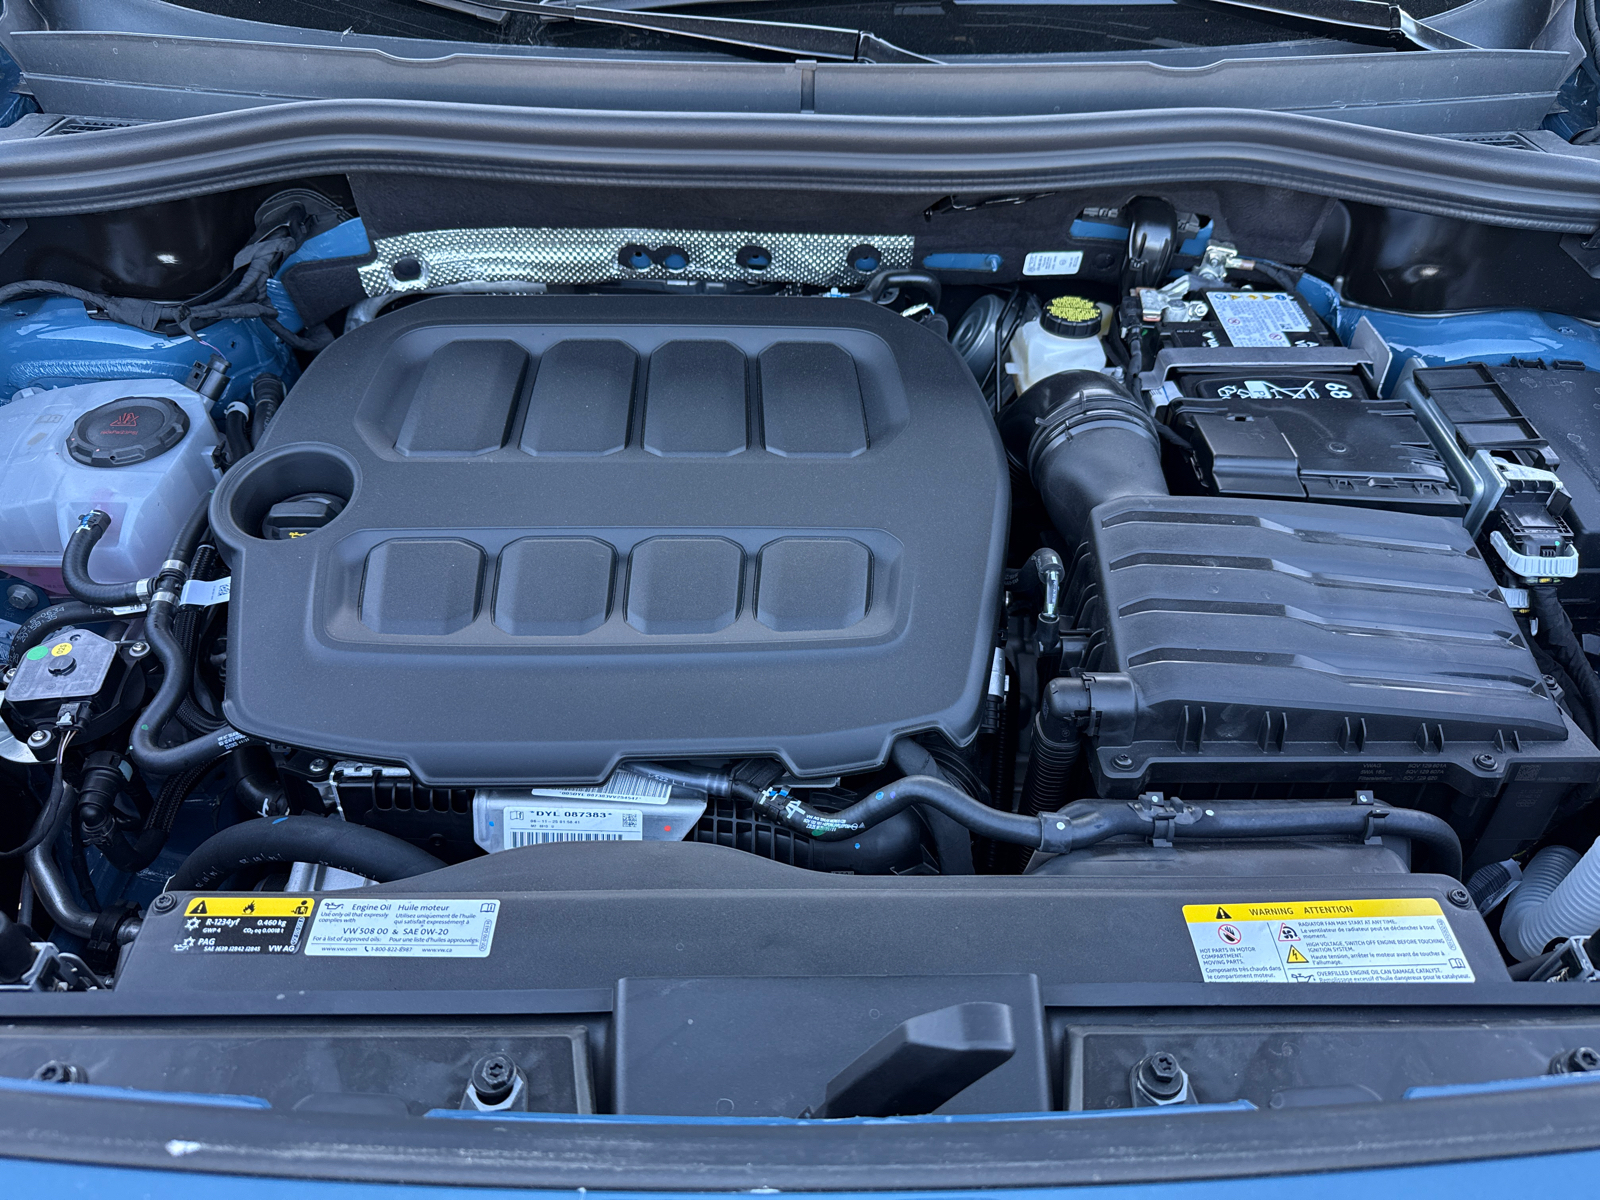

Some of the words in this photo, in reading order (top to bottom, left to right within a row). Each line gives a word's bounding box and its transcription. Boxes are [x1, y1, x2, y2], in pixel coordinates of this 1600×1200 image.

[352, 904, 378, 912] Engine
[1248, 907, 1294, 916] WARNING
[1303, 906, 1354, 914] ATTENTION
[205, 918, 241, 928] R-1234yf
[277, 919, 287, 927] kg
[343, 927, 358, 935] VW
[359, 927, 375, 935] 508
[376, 927, 389, 935] 00
[197, 938, 216, 946] PAG
